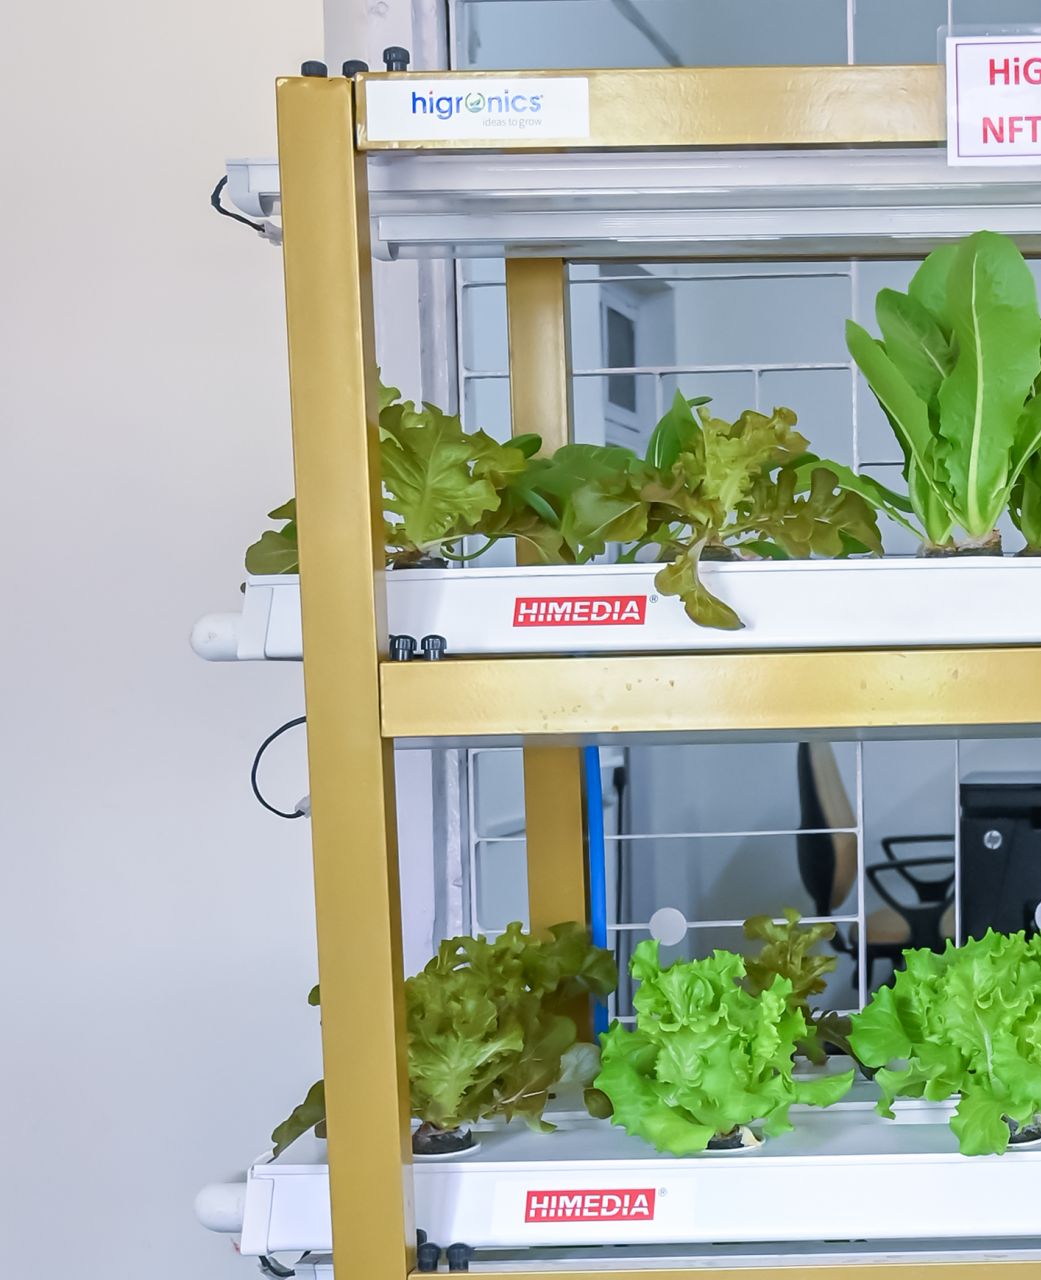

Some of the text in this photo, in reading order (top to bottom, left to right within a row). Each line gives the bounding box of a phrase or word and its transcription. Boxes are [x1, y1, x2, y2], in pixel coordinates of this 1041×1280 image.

[411, 88, 543, 121] higronics
[482, 116, 543, 130] ideas to grow
[517, 599, 641, 623] HIMEDIA
[528, 1193, 650, 1218] HIMEDIA
